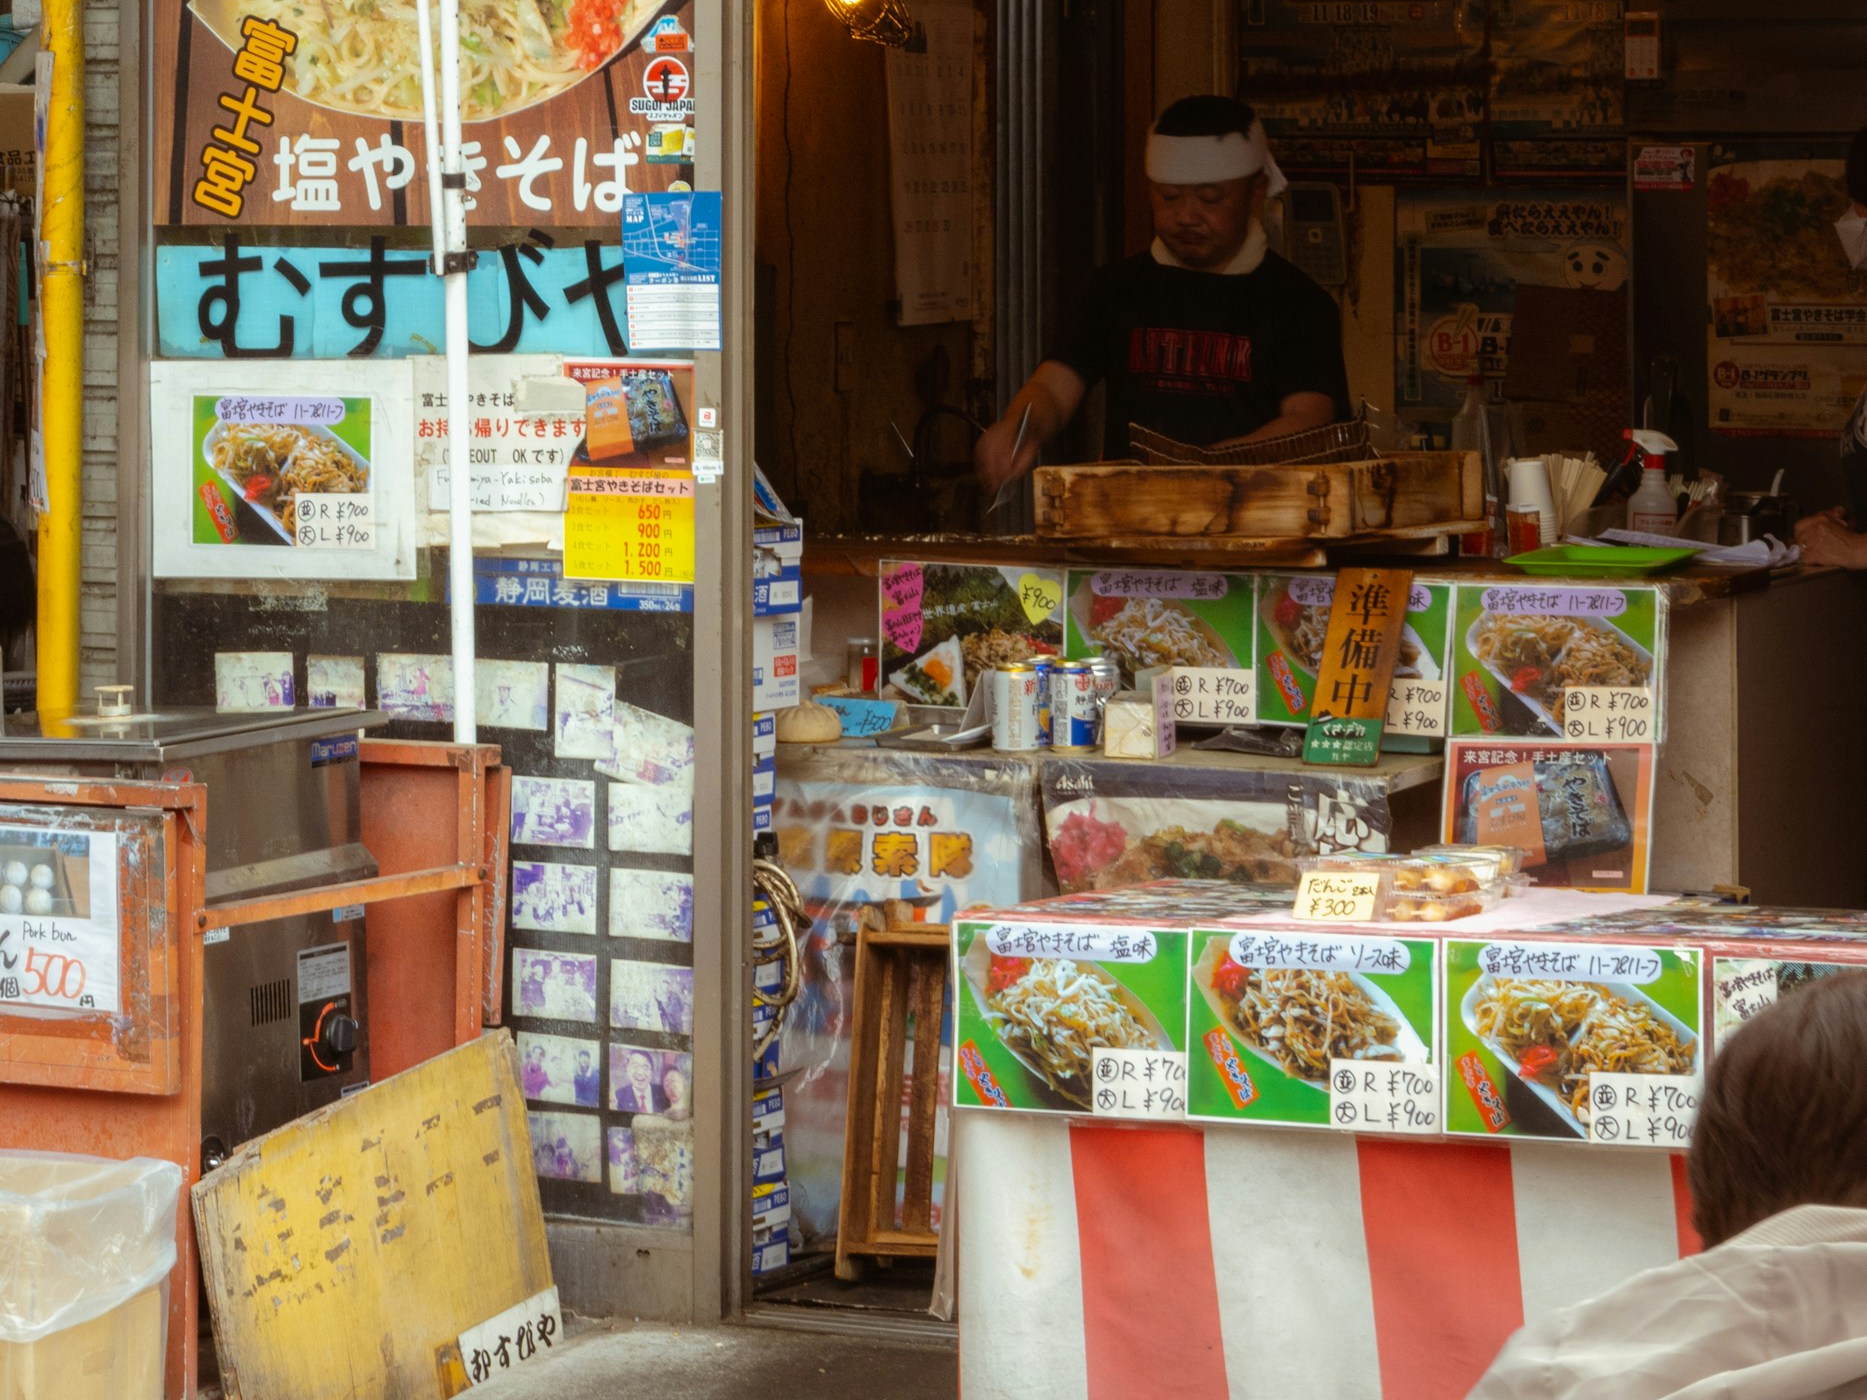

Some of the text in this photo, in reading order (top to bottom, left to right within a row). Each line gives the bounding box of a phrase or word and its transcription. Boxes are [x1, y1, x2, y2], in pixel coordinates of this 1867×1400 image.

[193, 15, 299, 220] 富士宮
[421, 392, 515, 408] 富士やきそば
[418, 417, 586, 440] お持帰りできます
[319, 503, 331, 519] R
[336, 501, 370, 520] ¥700
[637, 503, 661, 520] 650
[319, 527, 330, 542] L
[335, 525, 370, 543] ¥900
[637, 523, 661, 539] 900
[495, 576, 609, 607] 静岡麦酒
[1189, 575, 1226, 598] 塩味
[1021, 583, 1057, 611] ¥900
[1331, 583, 1391, 716] 準備中
[1197, 679, 1210, 694] R
[1215, 679, 1250, 697] ¥700
[1404, 687, 1443, 704] ¥700
[1198, 700, 1210, 717] L
[1214, 699, 1250, 719] ¥900
[1590, 695, 1602, 710] R
[1608, 692, 1649, 710] ¥700
[1401, 711, 1439, 730] ¥900
[1588, 721, 1600, 737] L
[1604, 716, 1648, 739] ¥900
[311, 740, 357, 758] Maruzen
[1055, 774, 1095, 791] Asahi
[1307, 877, 1354, 895] だんご
[1309, 897, 1356, 917] ¥300
[22, 919, 78, 942] Pork bun
[1109, 934, 1157, 961] 塩味
[22, 946, 87, 1000] 500
[1122, 1062, 1136, 1082] R
[1363, 1074, 1377, 1094] R
[1386, 1069, 1434, 1098] ¥700
[1122, 1091, 1136, 1110] L
[1626, 1087, 1641, 1107] R
[1648, 1085, 1698, 1110] ¥700
[1363, 1104, 1377, 1122] L
[1387, 1102, 1436, 1129] ¥900
[1626, 1119, 1641, 1141] L
